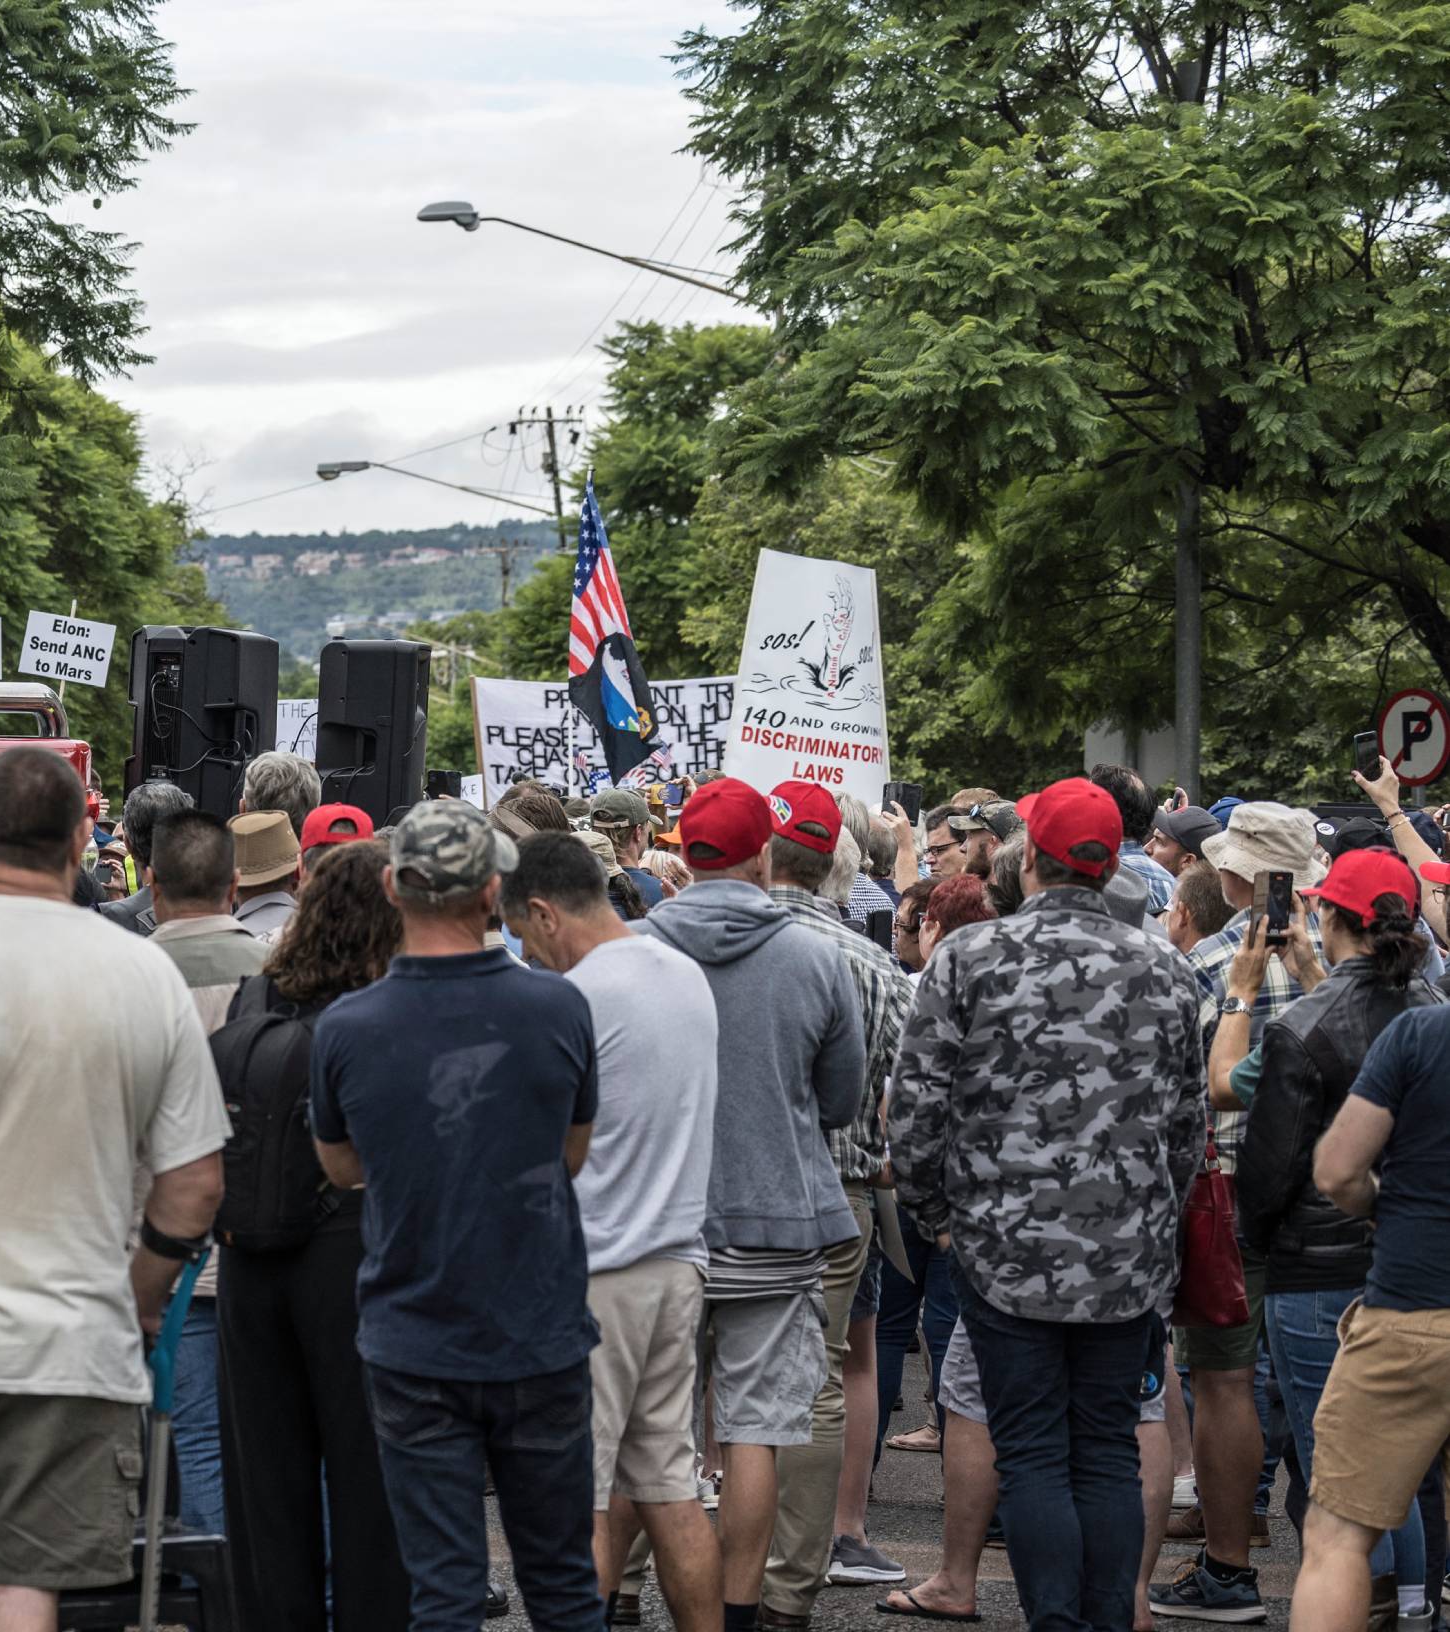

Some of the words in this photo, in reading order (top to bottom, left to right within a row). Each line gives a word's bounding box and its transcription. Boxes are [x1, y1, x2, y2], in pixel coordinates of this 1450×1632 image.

[52, 618, 91, 638] Elon:
[759, 620, 816, 650] SOS!
[29, 635, 69, 656] Send
[71, 644, 106, 663] ANC
[35, 658, 50, 674] to
[54, 662, 93, 681] Mars
[699, 682, 734, 703] TR
[277, 702, 311, 719] THE
[700, 702, 733, 724] MU
[743, 706, 786, 729] 140
[789, 716, 824, 729] AND
[486, 725, 578, 748] PLEASE
[671, 722, 719, 743] THE
[741, 725, 884, 765] DISCRIMINATORY
[1401, 710, 1433, 762] P
[792, 761, 845, 785] LAWS
